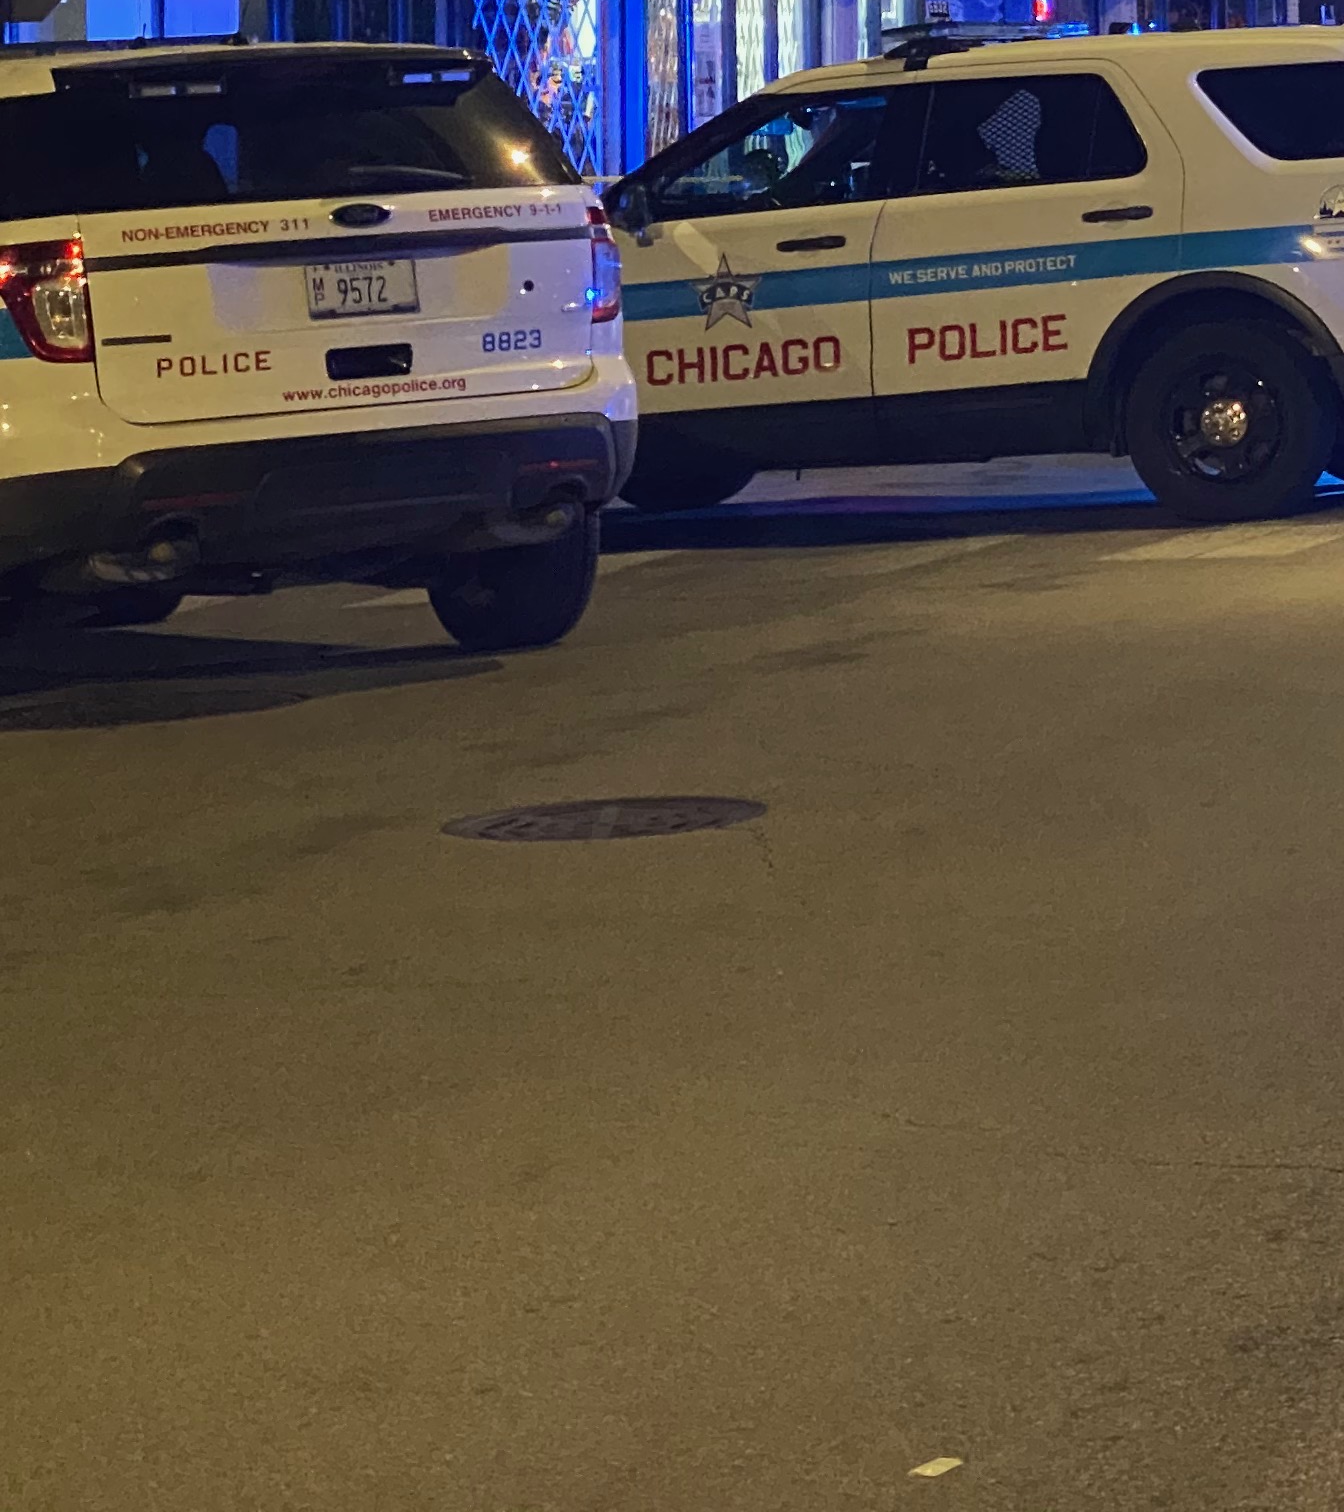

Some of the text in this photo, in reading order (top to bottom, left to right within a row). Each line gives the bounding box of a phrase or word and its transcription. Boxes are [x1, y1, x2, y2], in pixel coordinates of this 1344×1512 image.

[428, 203, 562, 222] EMERGENCY 9-1-1
[121, 218, 310, 243] NON-EMERGENCY 311
[889, 255, 1077, 285] WE SERVE AND PROTECT
[337, 276, 388, 305] 9572
[702, 285, 750, 303] CAPS
[482, 329, 542, 353] 8823
[907, 313, 1069, 365] POLICE
[156, 350, 272, 378] POLICE
[646, 335, 841, 386] CHICAGO
[282, 375, 467, 403] www.chicagopolice.org
